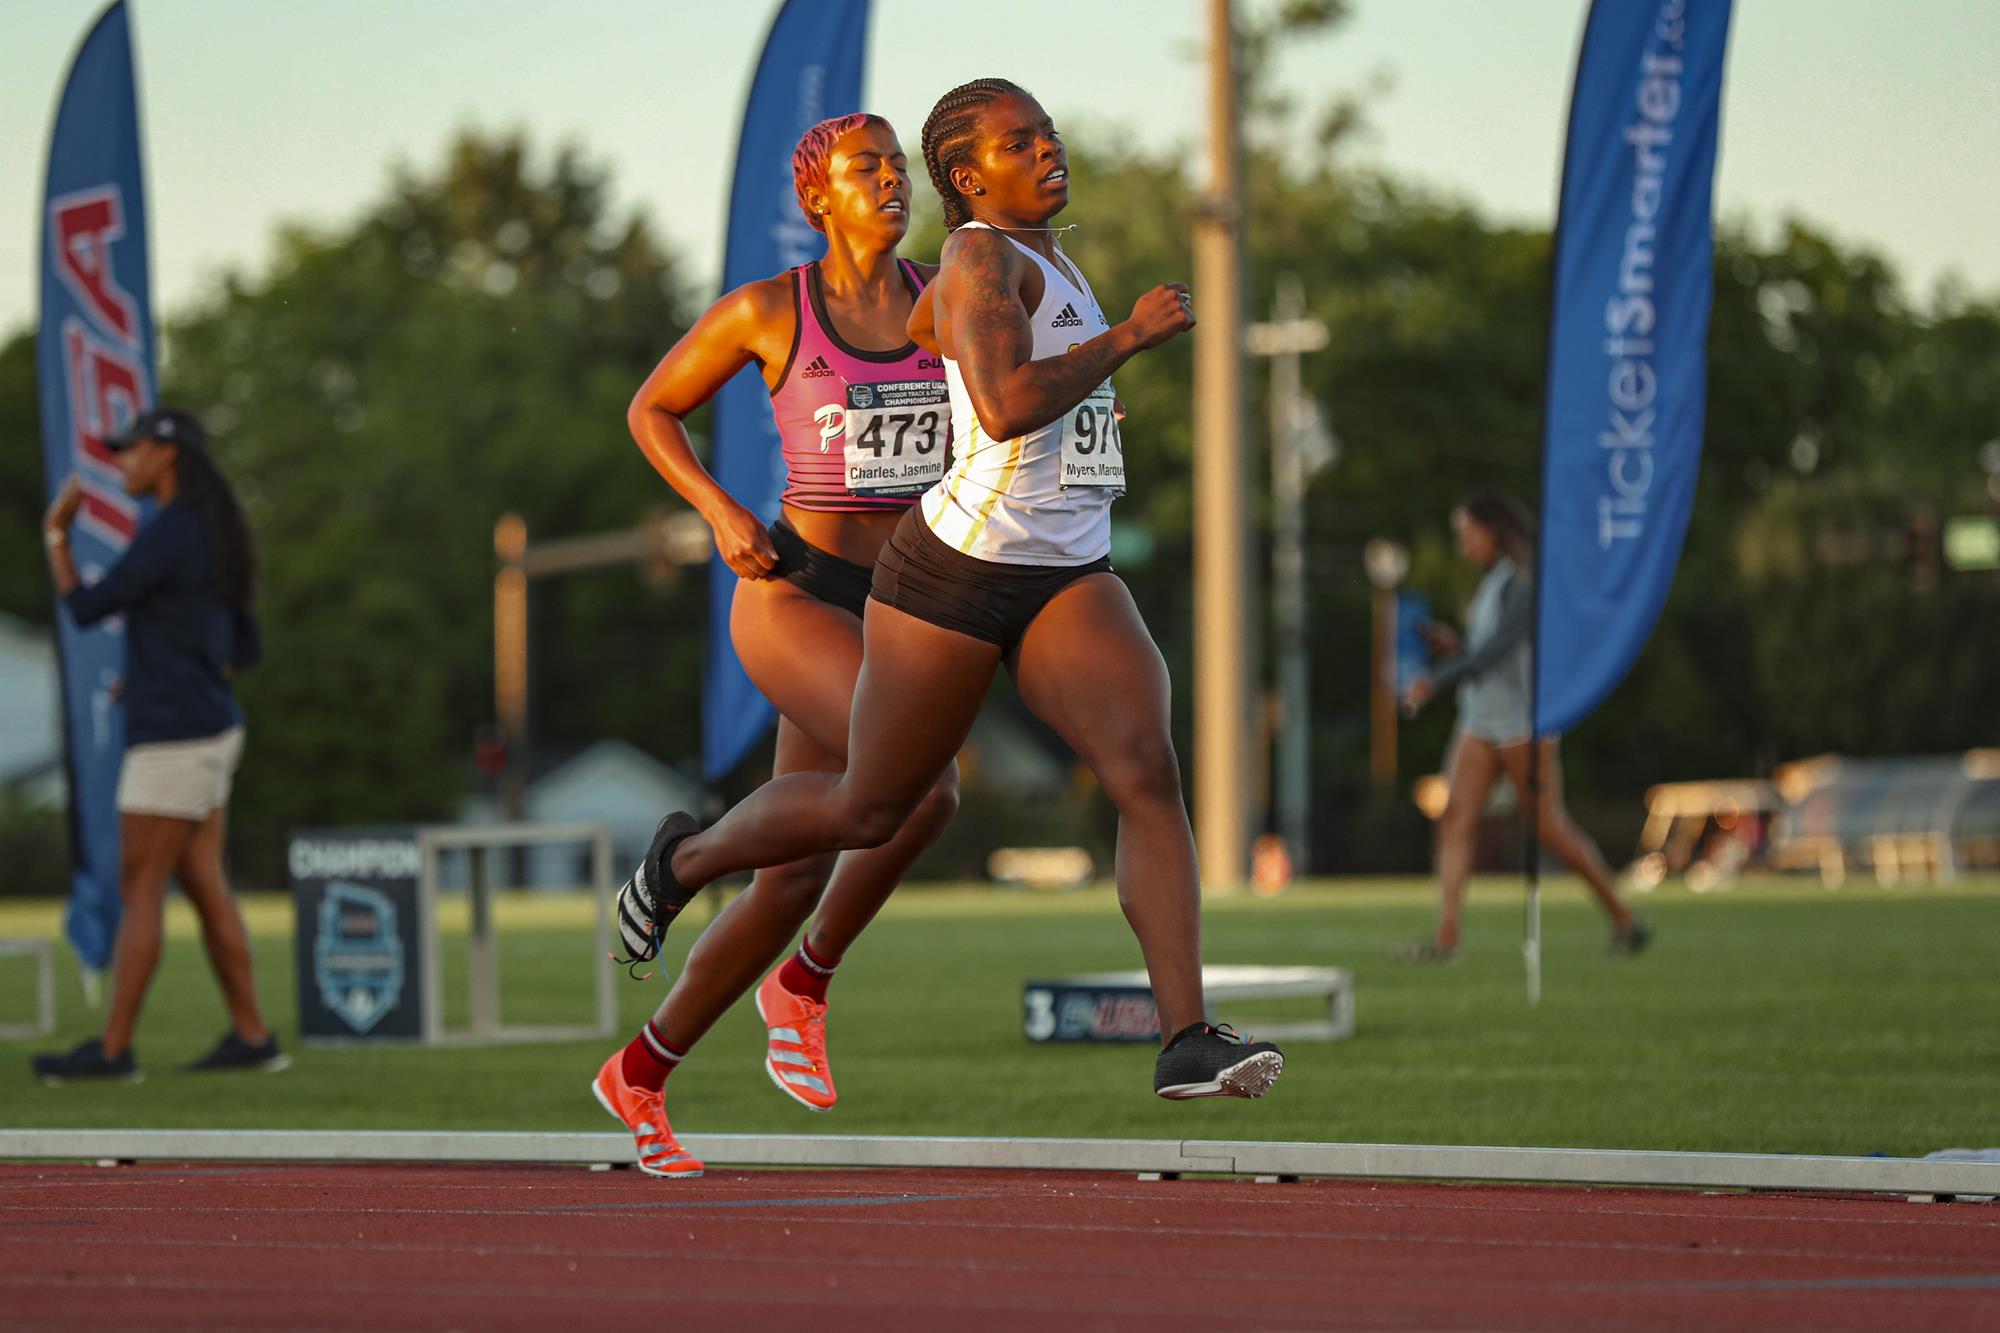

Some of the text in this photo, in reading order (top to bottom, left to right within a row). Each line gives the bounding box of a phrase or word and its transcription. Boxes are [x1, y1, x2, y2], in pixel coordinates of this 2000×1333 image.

[1051, 317, 1084, 328] adidas
[801, 367, 836, 379] adidas
[877, 382, 931, 392] CONFERENCE
[885, 396, 941, 406] CHAMPIONSHIPS
[857, 411, 939, 457] 473
[850, 462, 942, 480] Charles, Jasmine
[1066, 464, 1098, 478] Myers,
[1026, 989, 1056, 1041] 3
